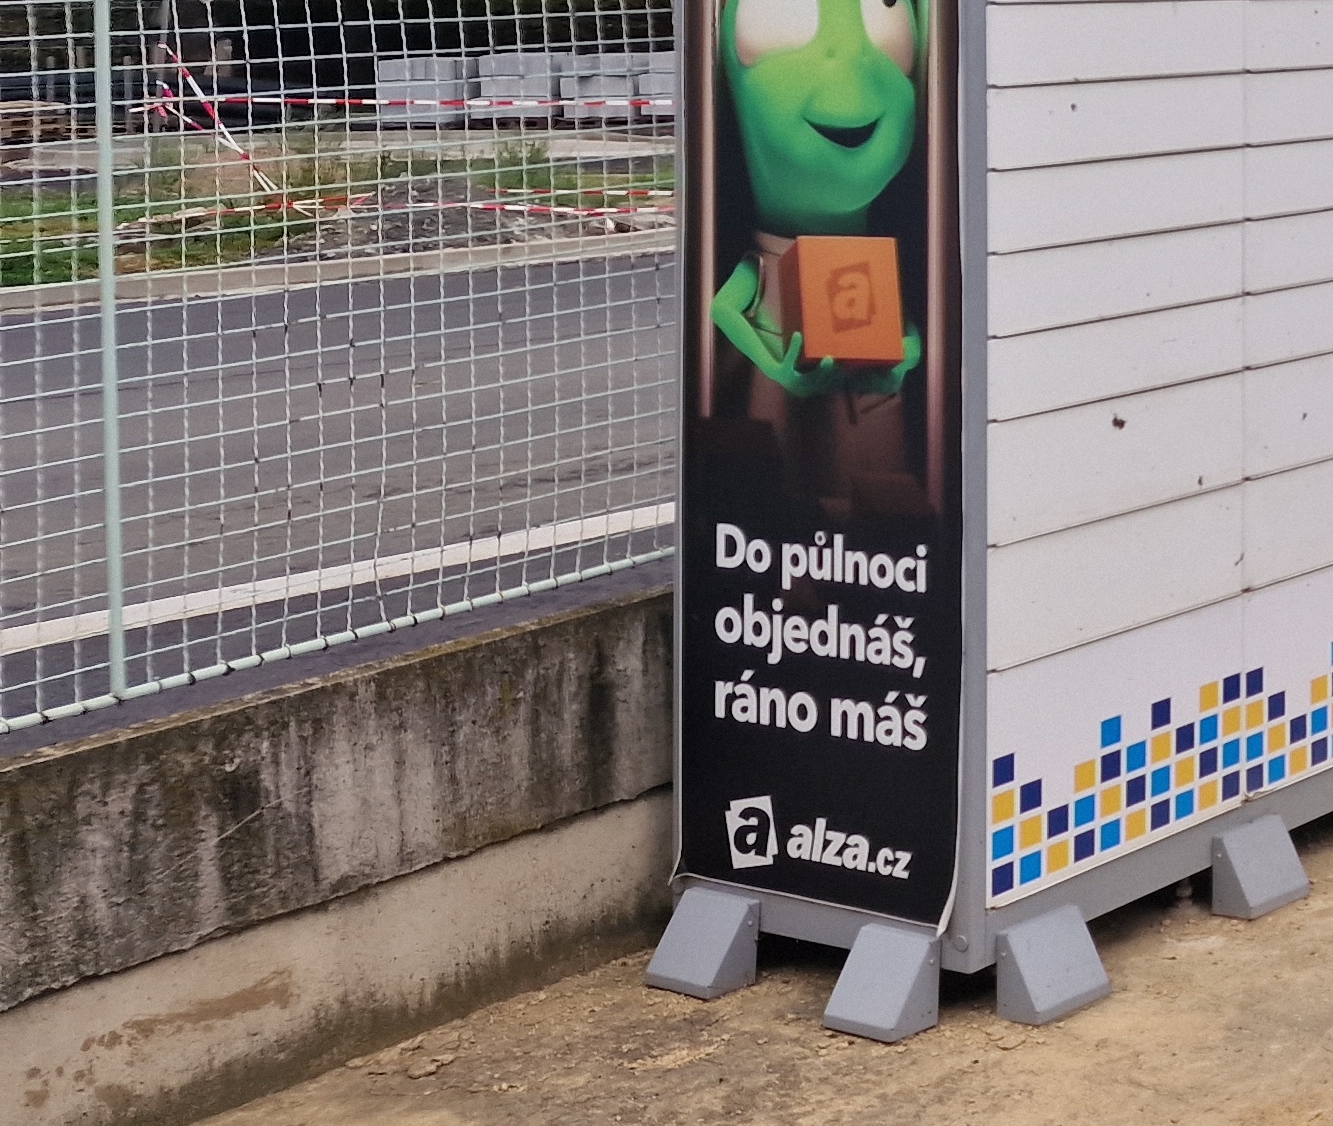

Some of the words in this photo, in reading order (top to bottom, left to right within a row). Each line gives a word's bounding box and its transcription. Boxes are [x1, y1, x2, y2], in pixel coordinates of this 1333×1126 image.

[715, 523, 772, 573] Do
[782, 531, 927, 593] půlnoci
[715, 593, 927, 679] objednáš,
[715, 669, 818, 733] ráno
[830, 691, 928, 751] máš
[787, 817, 912, 879] alza.cz
